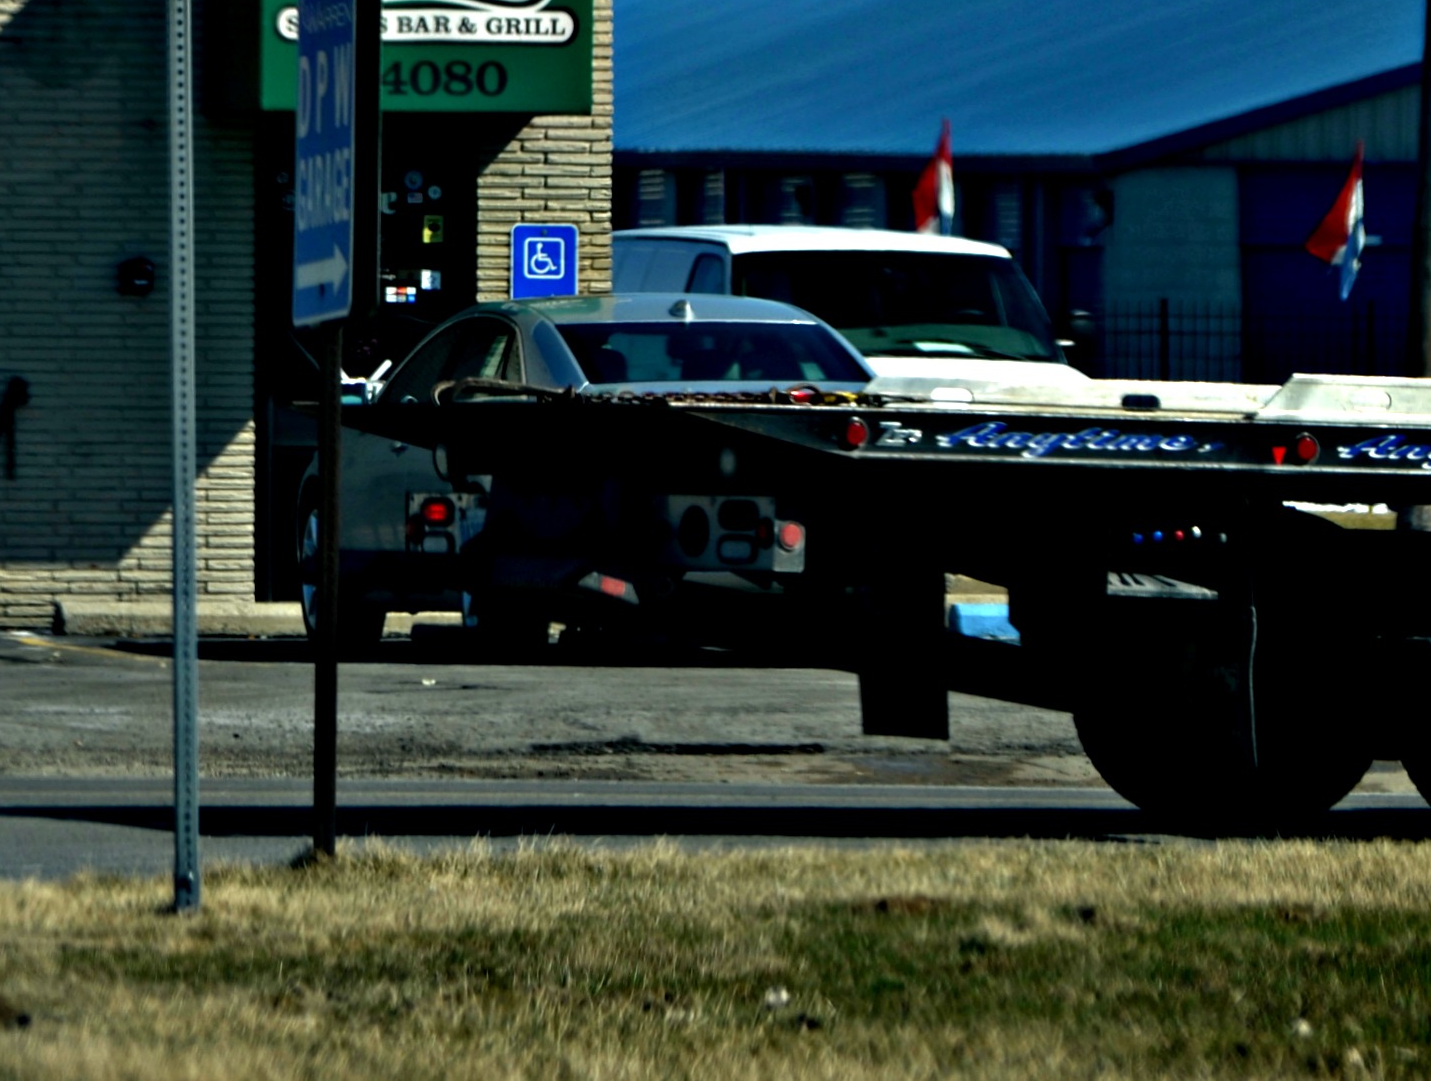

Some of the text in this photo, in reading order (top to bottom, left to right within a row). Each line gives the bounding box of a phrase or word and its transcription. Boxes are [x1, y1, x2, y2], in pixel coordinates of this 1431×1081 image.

[396, 16, 452, 35] BAR
[458, 17, 478, 34] &
[485, 17, 566, 36] GRILL
